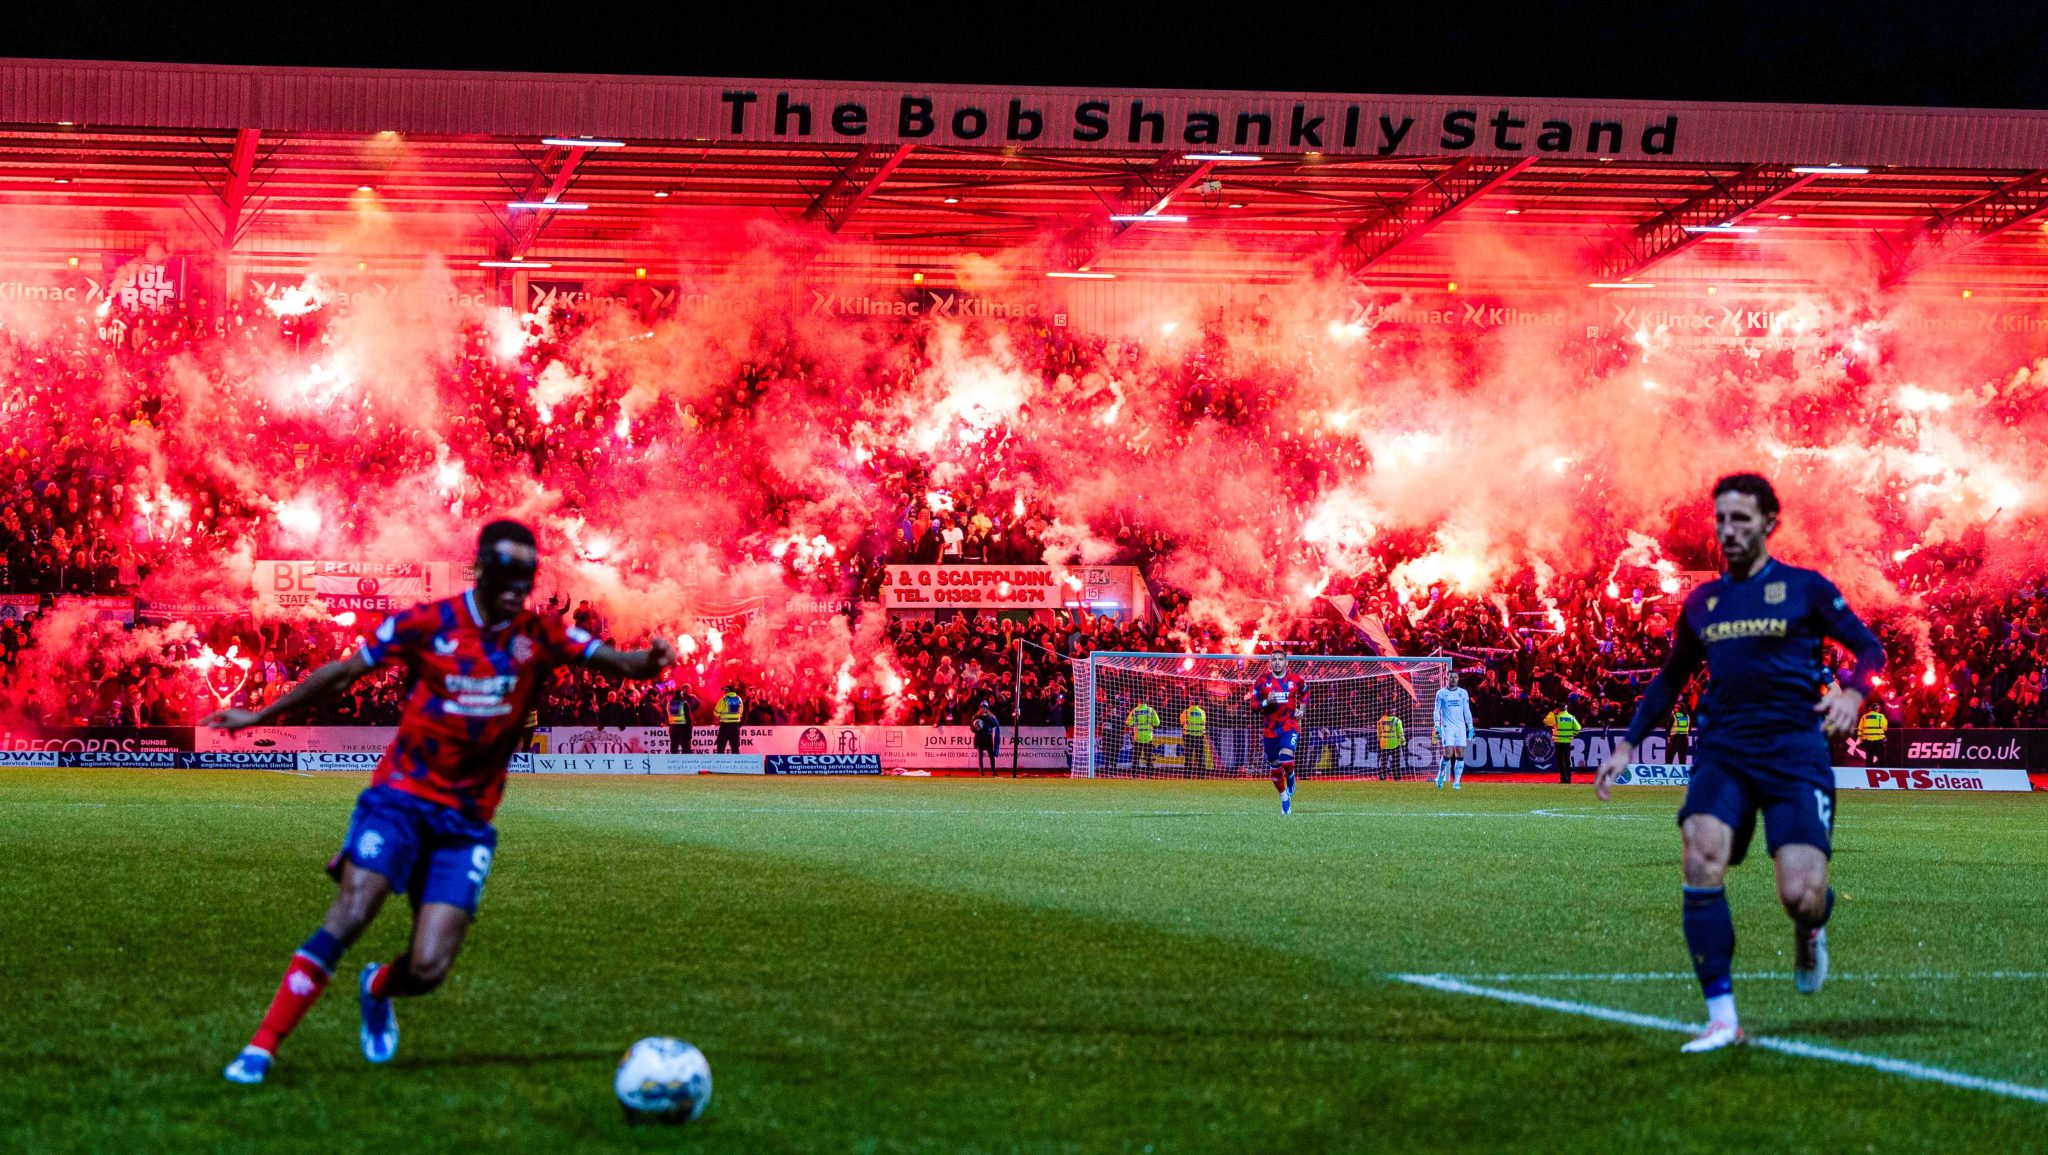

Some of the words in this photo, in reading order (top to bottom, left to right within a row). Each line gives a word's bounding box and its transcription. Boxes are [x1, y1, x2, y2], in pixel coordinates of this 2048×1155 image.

[721, 91, 868, 137] The
[901, 95, 1044, 142] Bob
[1073, 101, 1415, 155] Shankly
[1440, 109, 1679, 156] Stand
[839, 296, 919, 316] Kilmac
[958, 298, 1039, 318] Kilmac
[1640, 310, 1714, 329] Kilmac
[324, 561, 414, 576] RENFREW
[898, 571, 912, 586] &
[918, 571, 931, 586] G
[894, 589, 929, 602] TEL.
[935, 589, 982, 602] 01382
[986, 589, 1046, 602] 44674
[1086, 587, 1098, 598] 15
[326, 597, 411, 611] RANGERS
[1704, 618, 1788, 638] CROWN
[693, 729, 720, 737] HOME
[750, 729, 774, 737] SALE
[925, 736, 947, 746] JON
[1907, 737, 2022, 760] assai.co.uk
[0, 752, 55, 762] OWN
[79, 752, 174, 762] CROWN
[200, 753, 293, 763] CROWN
[319, 753, 385, 763] CROW
[787, 755, 877, 764] CROWN
[539, 759, 651, 770] WHYTES
